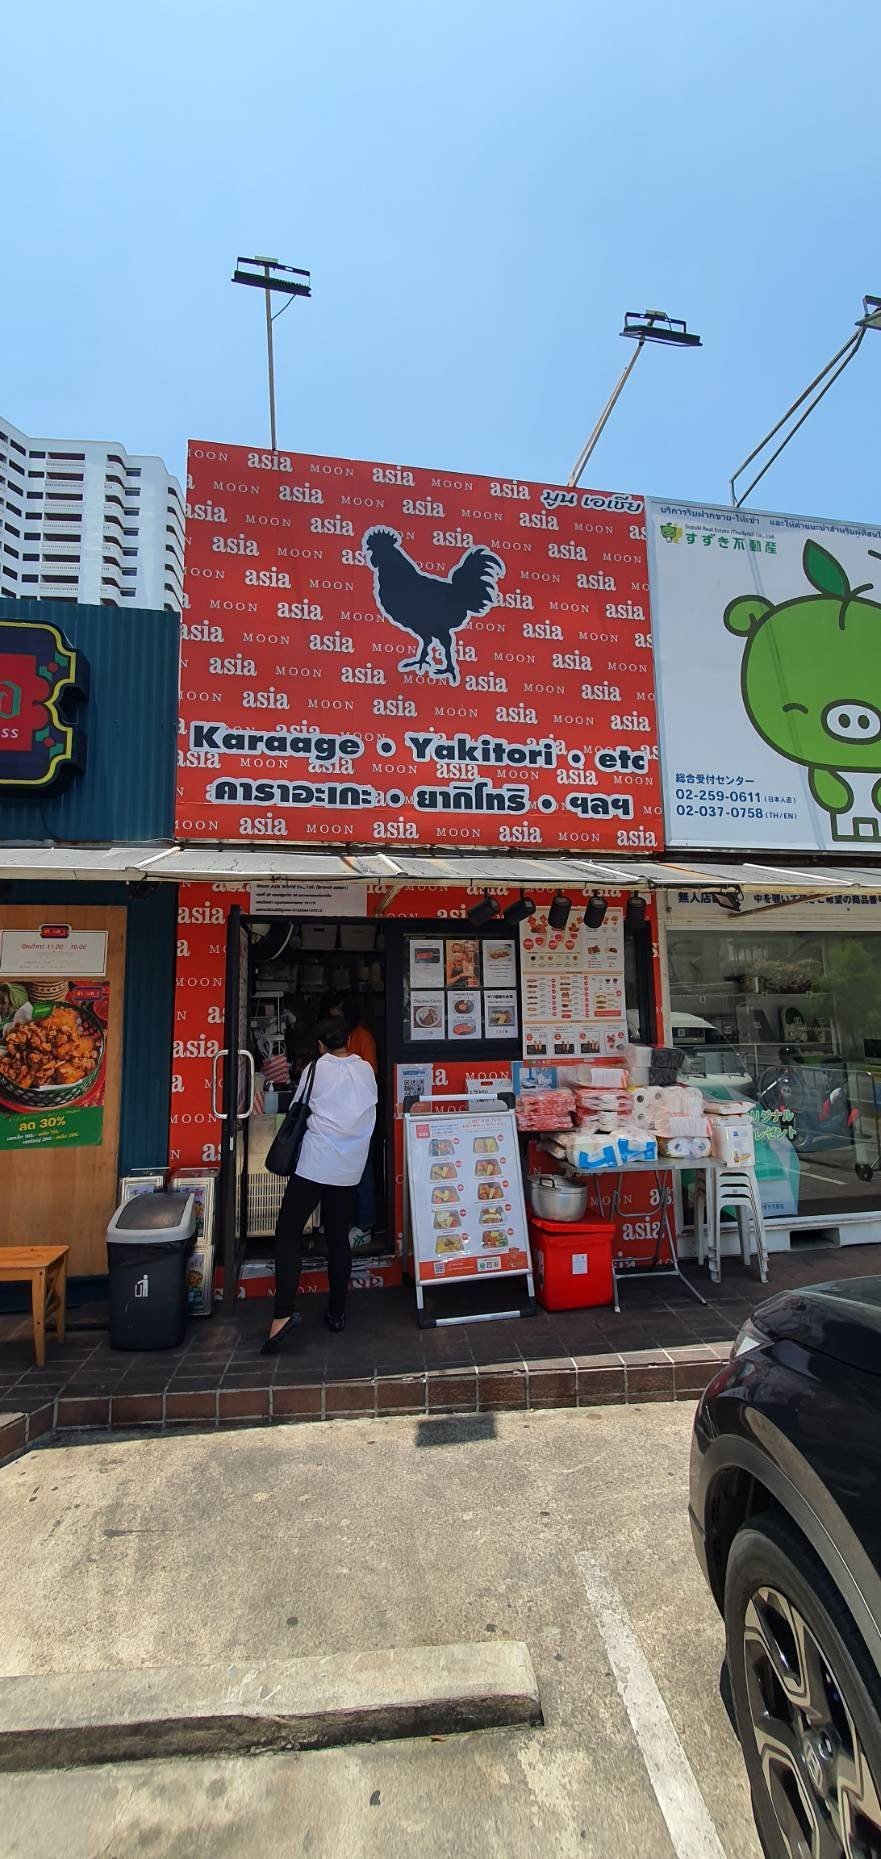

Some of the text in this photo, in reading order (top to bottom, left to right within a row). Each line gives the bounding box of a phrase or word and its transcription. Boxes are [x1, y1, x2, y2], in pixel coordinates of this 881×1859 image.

[248, 451, 293, 472] asia
[310, 464, 354, 476] MOON
[372, 465, 415, 486] asia
[431, 479, 473, 491] MOON
[490, 481, 530, 500] asia
[213, 481, 259, 494] MOON
[279, 483, 324, 504] asia
[341, 496, 384, 508] MOON
[402, 497, 445, 518] asia
[461, 509, 503, 521] MOON
[519, 510, 559, 530] asia
[575, 523, 613, 534] MOON
[583, 496, 641, 512] เอเชีย
[245, 514, 291, 527] MOON
[311, 515, 354, 536] asia
[433, 528, 475, 548] asia
[490, 540, 532, 551] MOON
[548, 541, 587, 561] asia
[604, 553, 642, 564] MOON
[686, 533, 776, 554] すずき不動産
[212, 534, 259, 556] asia
[278, 548, 323, 559] MOON
[520, 571, 560, 583] MOON
[577, 571, 616, 591] asia
[245, 567, 291, 589] asia
[309, 580, 354, 591] MOON
[494, 589, 534, 610] asia
[550, 602, 589, 613] MOON
[606, 600, 645, 620] asia
[210, 600, 257, 612] MOON
[277, 599, 323, 621] asia
[341, 612, 385, 623] MOON
[523, 620, 563, 640] asia
[579, 632, 618, 642] MOON
[243, 633, 289, 644] MOON
[310, 631, 354, 653] asia
[373, 643, 416, 654] MOON
[494, 652, 535, 663] MOON
[552, 651, 593, 671] asia
[608, 662, 647, 673] MOON
[209, 654, 257, 676] asia
[276, 666, 322, 677] MOON
[341, 663, 386, 685] asia
[404, 675, 447, 685] MOON
[466, 672, 508, 693] asia
[524, 683, 565, 694] MOON
[581, 681, 621, 701] asia
[242, 687, 289, 710] asia
[308, 700, 354, 710] MOON
[373, 695, 417, 717] asia
[434, 707, 478, 717] MOON
[496, 703, 538, 724] asia
[554, 715, 594, 725] MOON
[611, 711, 650, 731] asia
[193, 725, 360, 760] Karaage
[410, 738, 553, 765] Yakitori
[599, 750, 645, 770] etc
[240, 758, 288, 768] MOON
[373, 764, 417, 774] MOON
[497, 770, 539, 779] MOON
[614, 776, 653, 785] MOON
[676, 773, 754, 785] 総合受付センター
[215, 781, 372, 805] คาราอะเกะ
[569, 796, 630, 816] ฯลฯ
[676, 789, 760, 802] 02-259-0611
[677, 805, 763, 818] 02-037-0758
[240, 812, 288, 835] asia
[307, 824, 353, 834] MOON
[373, 817, 419, 838] asia
[437, 828, 480, 837] MOON
[499, 821, 542, 843] asia
[559, 832, 600, 842] MOON
[617, 826, 657, 847] asia
[177, 902, 226, 924] asia
[176, 978, 222, 986] MOON
[174, 1034, 220, 1058] asia
[40, 1116, 66, 1128] 30%
[749, 1109, 794, 1123] リジナル
